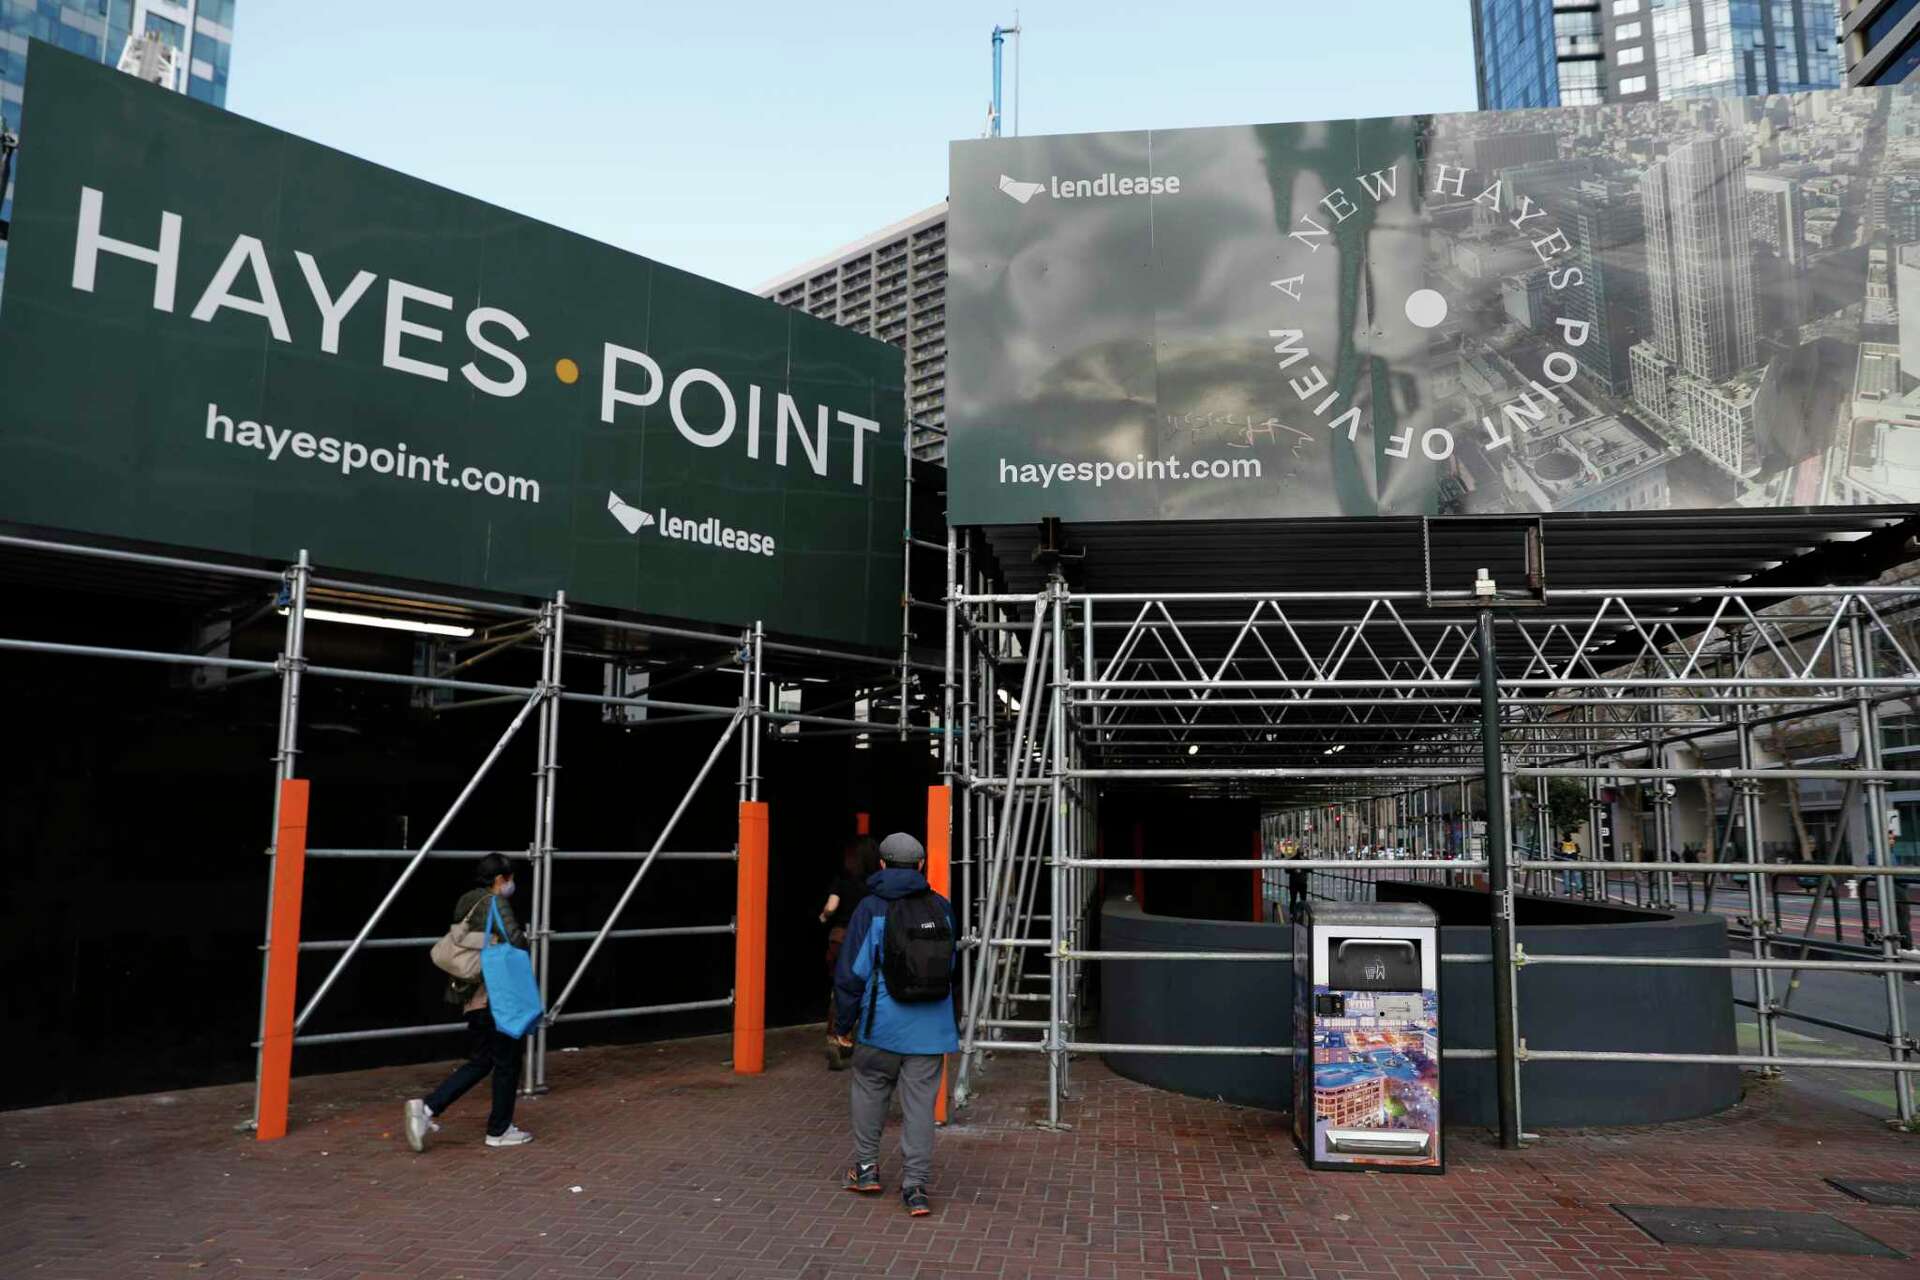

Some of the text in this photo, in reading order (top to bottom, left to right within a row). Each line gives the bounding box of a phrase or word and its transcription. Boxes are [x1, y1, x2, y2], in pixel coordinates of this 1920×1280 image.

[1051, 172, 1181, 199] lendlease
[1288, 166, 1398, 252] NEW
[1432, 164, 1584, 291] HAYES
[1271, 273, 1305, 301] A
[72, 186, 880, 486] HAYES POINT
[1268, 329, 1362, 442] VIEW
[1482, 317, 1590, 451] POINT
[205, 403, 541, 504] hayespoint.com
[999, 453, 1262, 489] hayespoint.com
[1384, 427, 1454, 461] OF
[658, 507, 776, 557] lendlease
